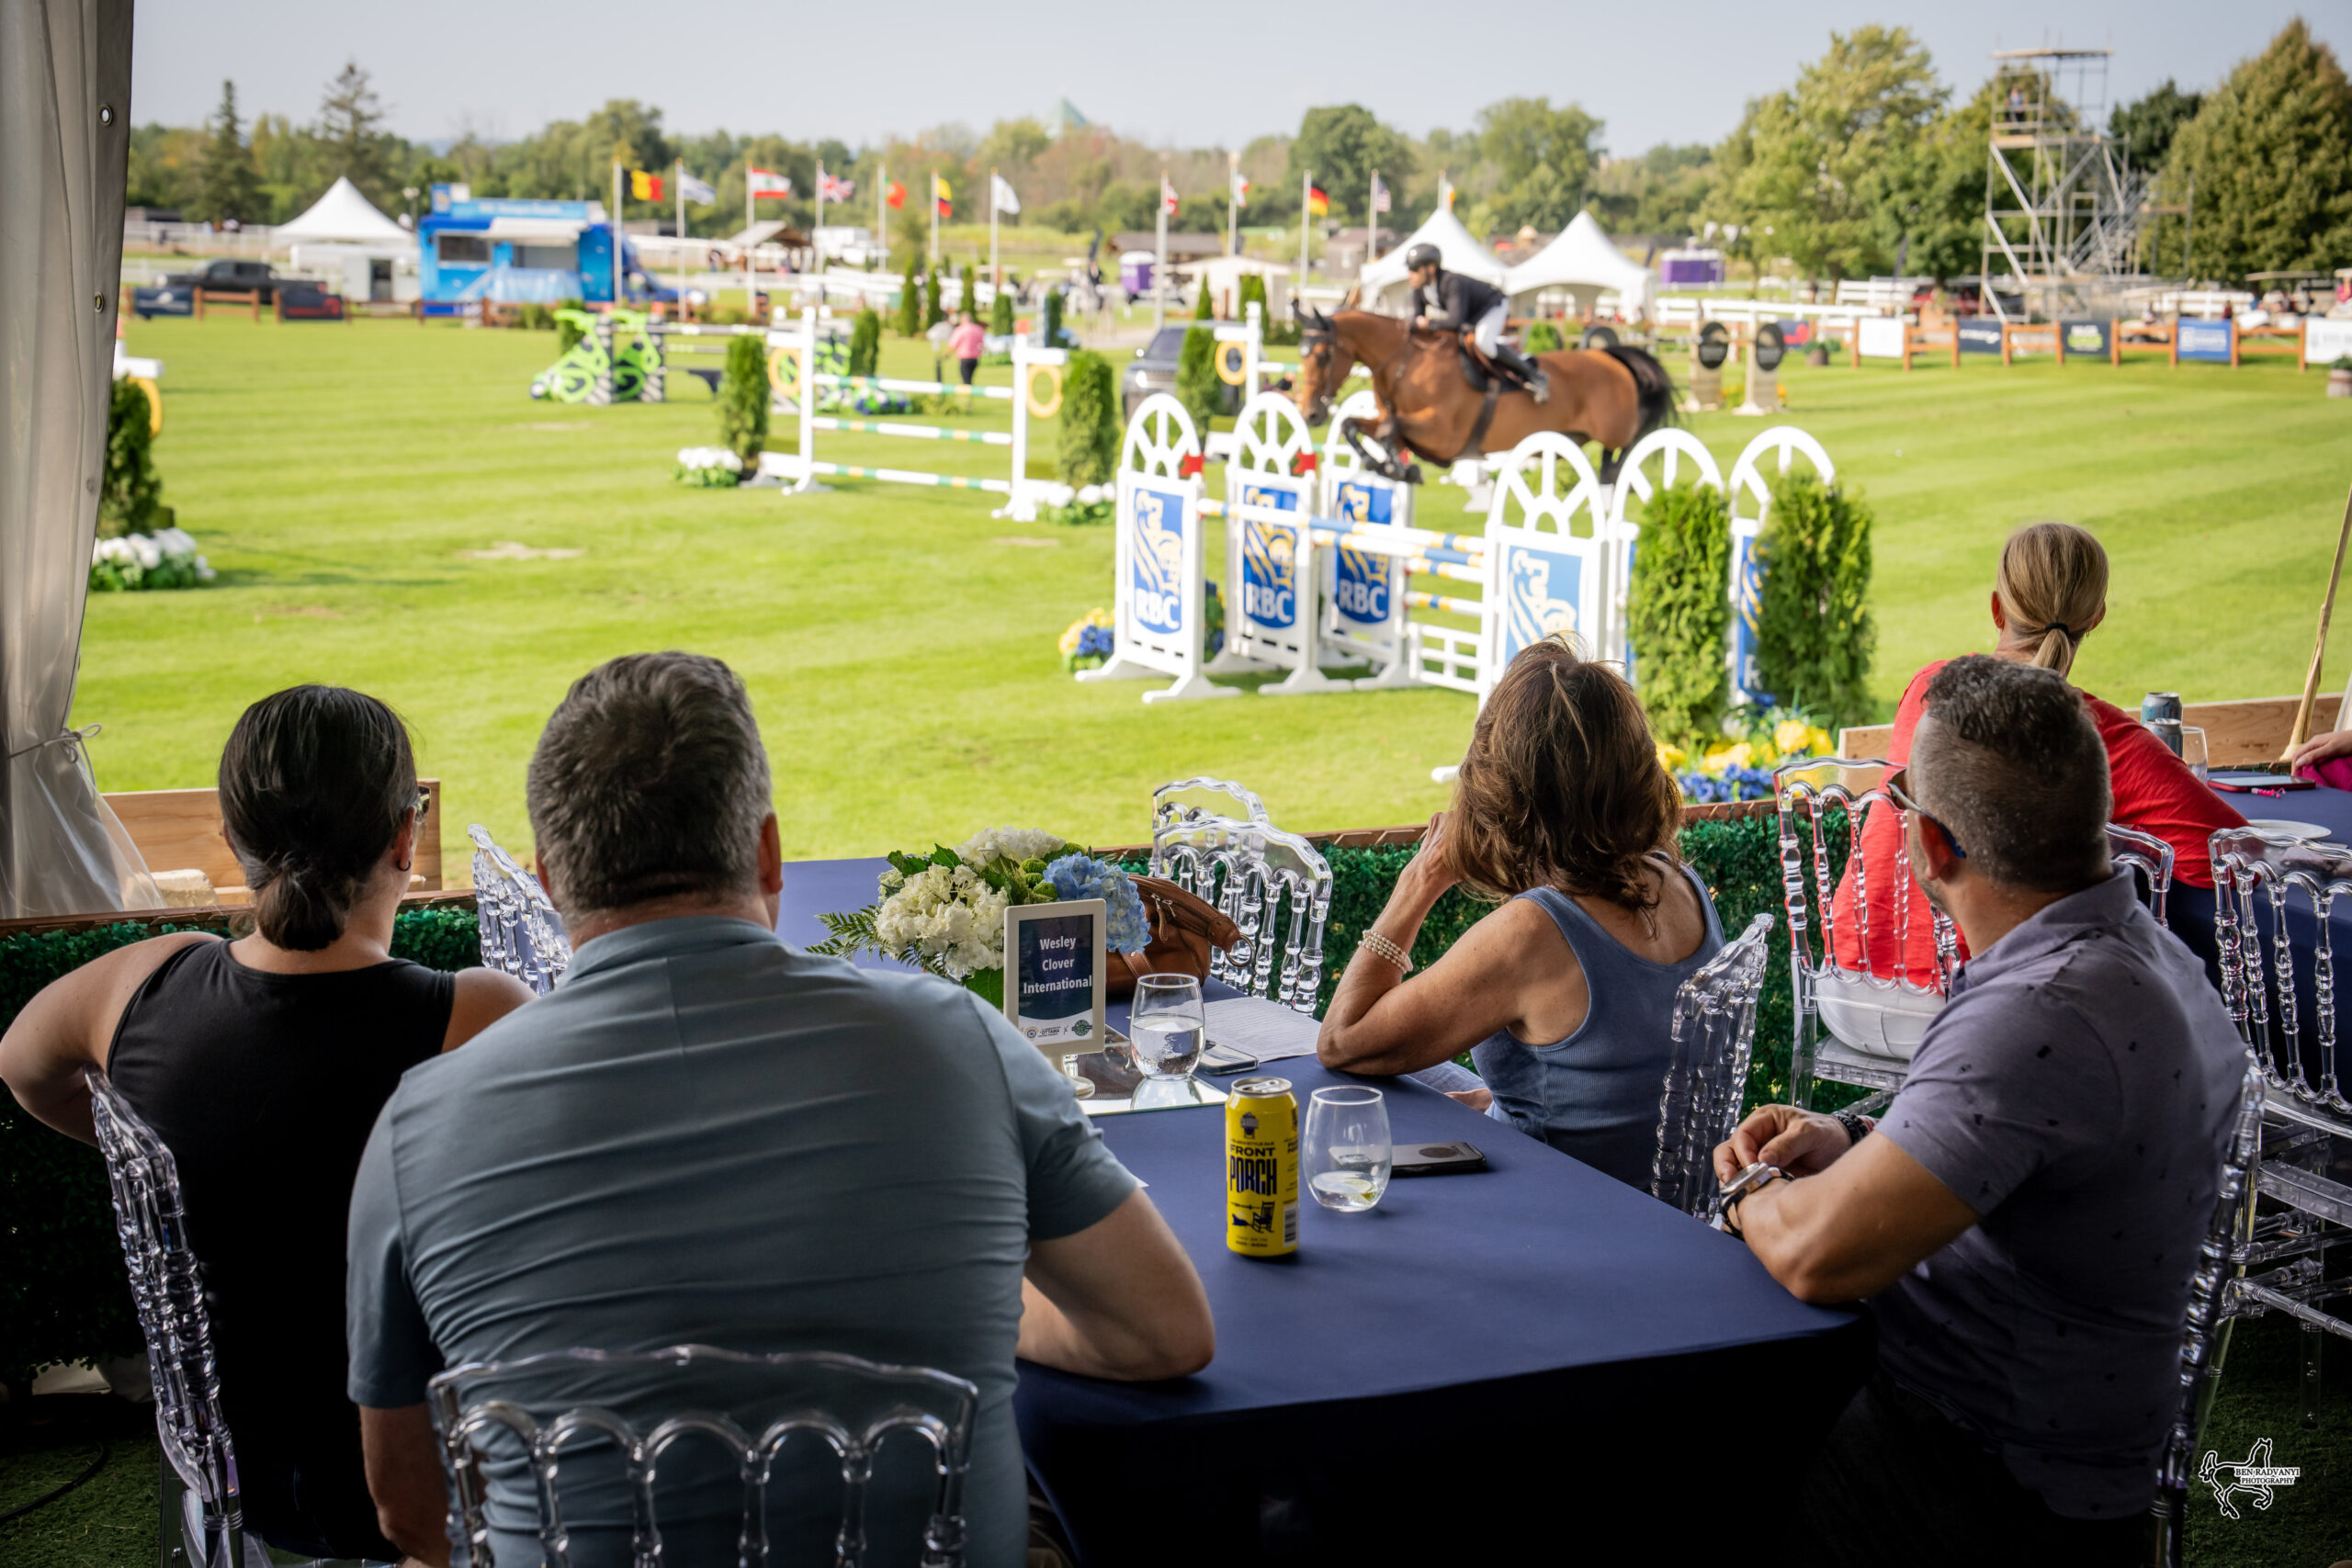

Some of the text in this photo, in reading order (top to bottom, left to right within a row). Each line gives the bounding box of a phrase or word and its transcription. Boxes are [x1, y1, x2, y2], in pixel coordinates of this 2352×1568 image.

[1136, 588, 1181, 630] RBC
[1245, 581, 1294, 624] RBC
[1339, 578, 1387, 619] RBC
[1039, 936, 1076, 950] Wesley
[1042, 958, 1075, 971] Clover
[1023, 975, 1092, 994] International
[1230, 1144, 1276, 1157] FRONT
[1230, 1155, 1277, 1196] PORCH
